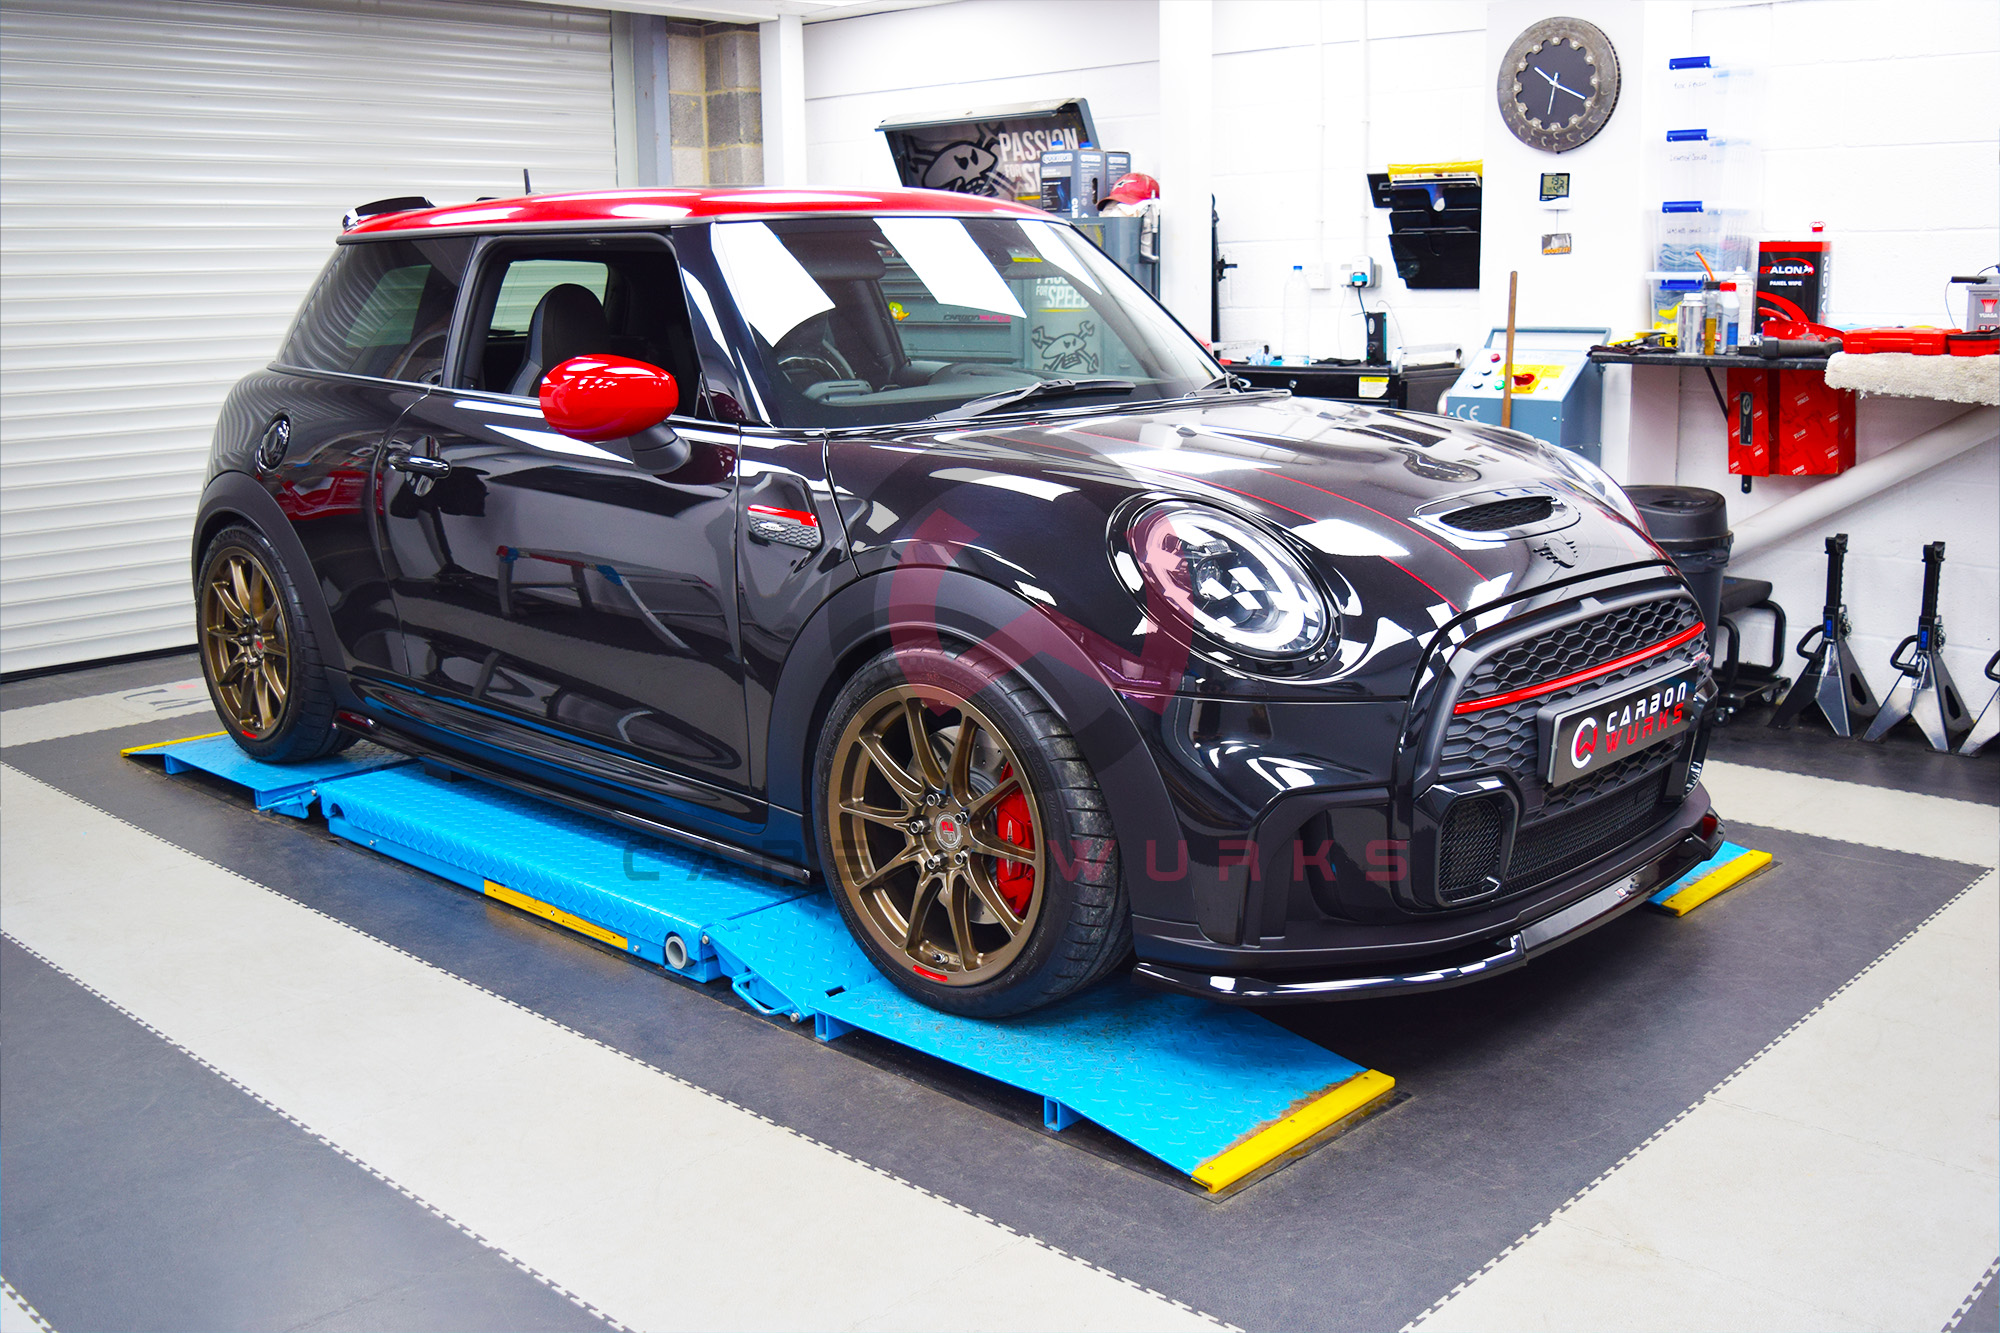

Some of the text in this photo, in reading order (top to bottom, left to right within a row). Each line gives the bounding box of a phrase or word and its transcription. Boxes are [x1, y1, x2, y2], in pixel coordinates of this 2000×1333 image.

[999, 128, 1079, 162] PASSION
[1605, 702, 1685, 754] WURKS
[1606, 681, 1687, 733] CARBON
